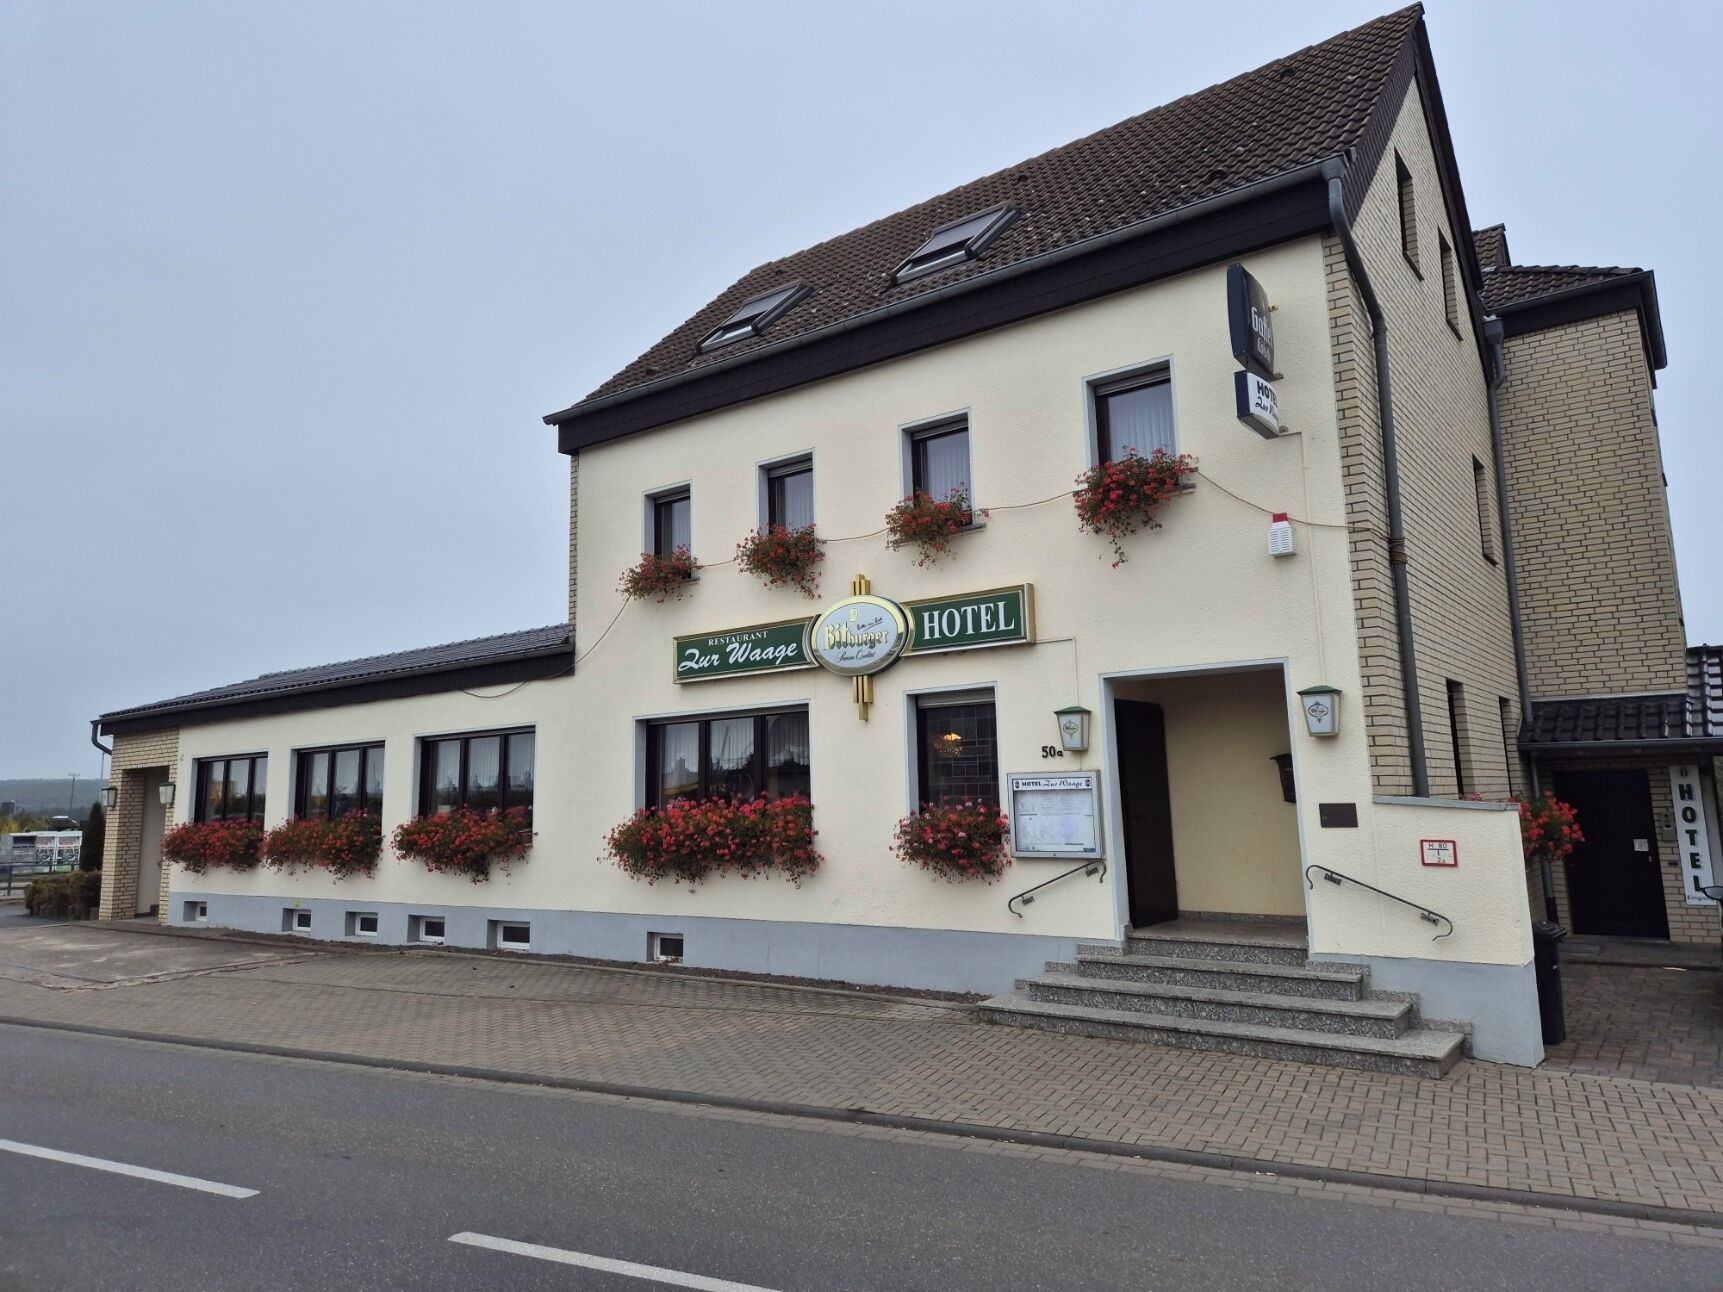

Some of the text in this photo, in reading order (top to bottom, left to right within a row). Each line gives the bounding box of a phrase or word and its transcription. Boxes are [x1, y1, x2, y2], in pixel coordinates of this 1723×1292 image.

[922, 601, 1015, 640] HOTEL
[708, 631, 769, 646] RESTAURANT
[824, 621, 889, 650] Bitburger
[677, 640, 798, 672] Zur Waage
[1041, 745, 1064, 759] 50a
[1021, 779, 1042, 788] HOTEL
[1678, 783, 1705, 893] HOTEL
